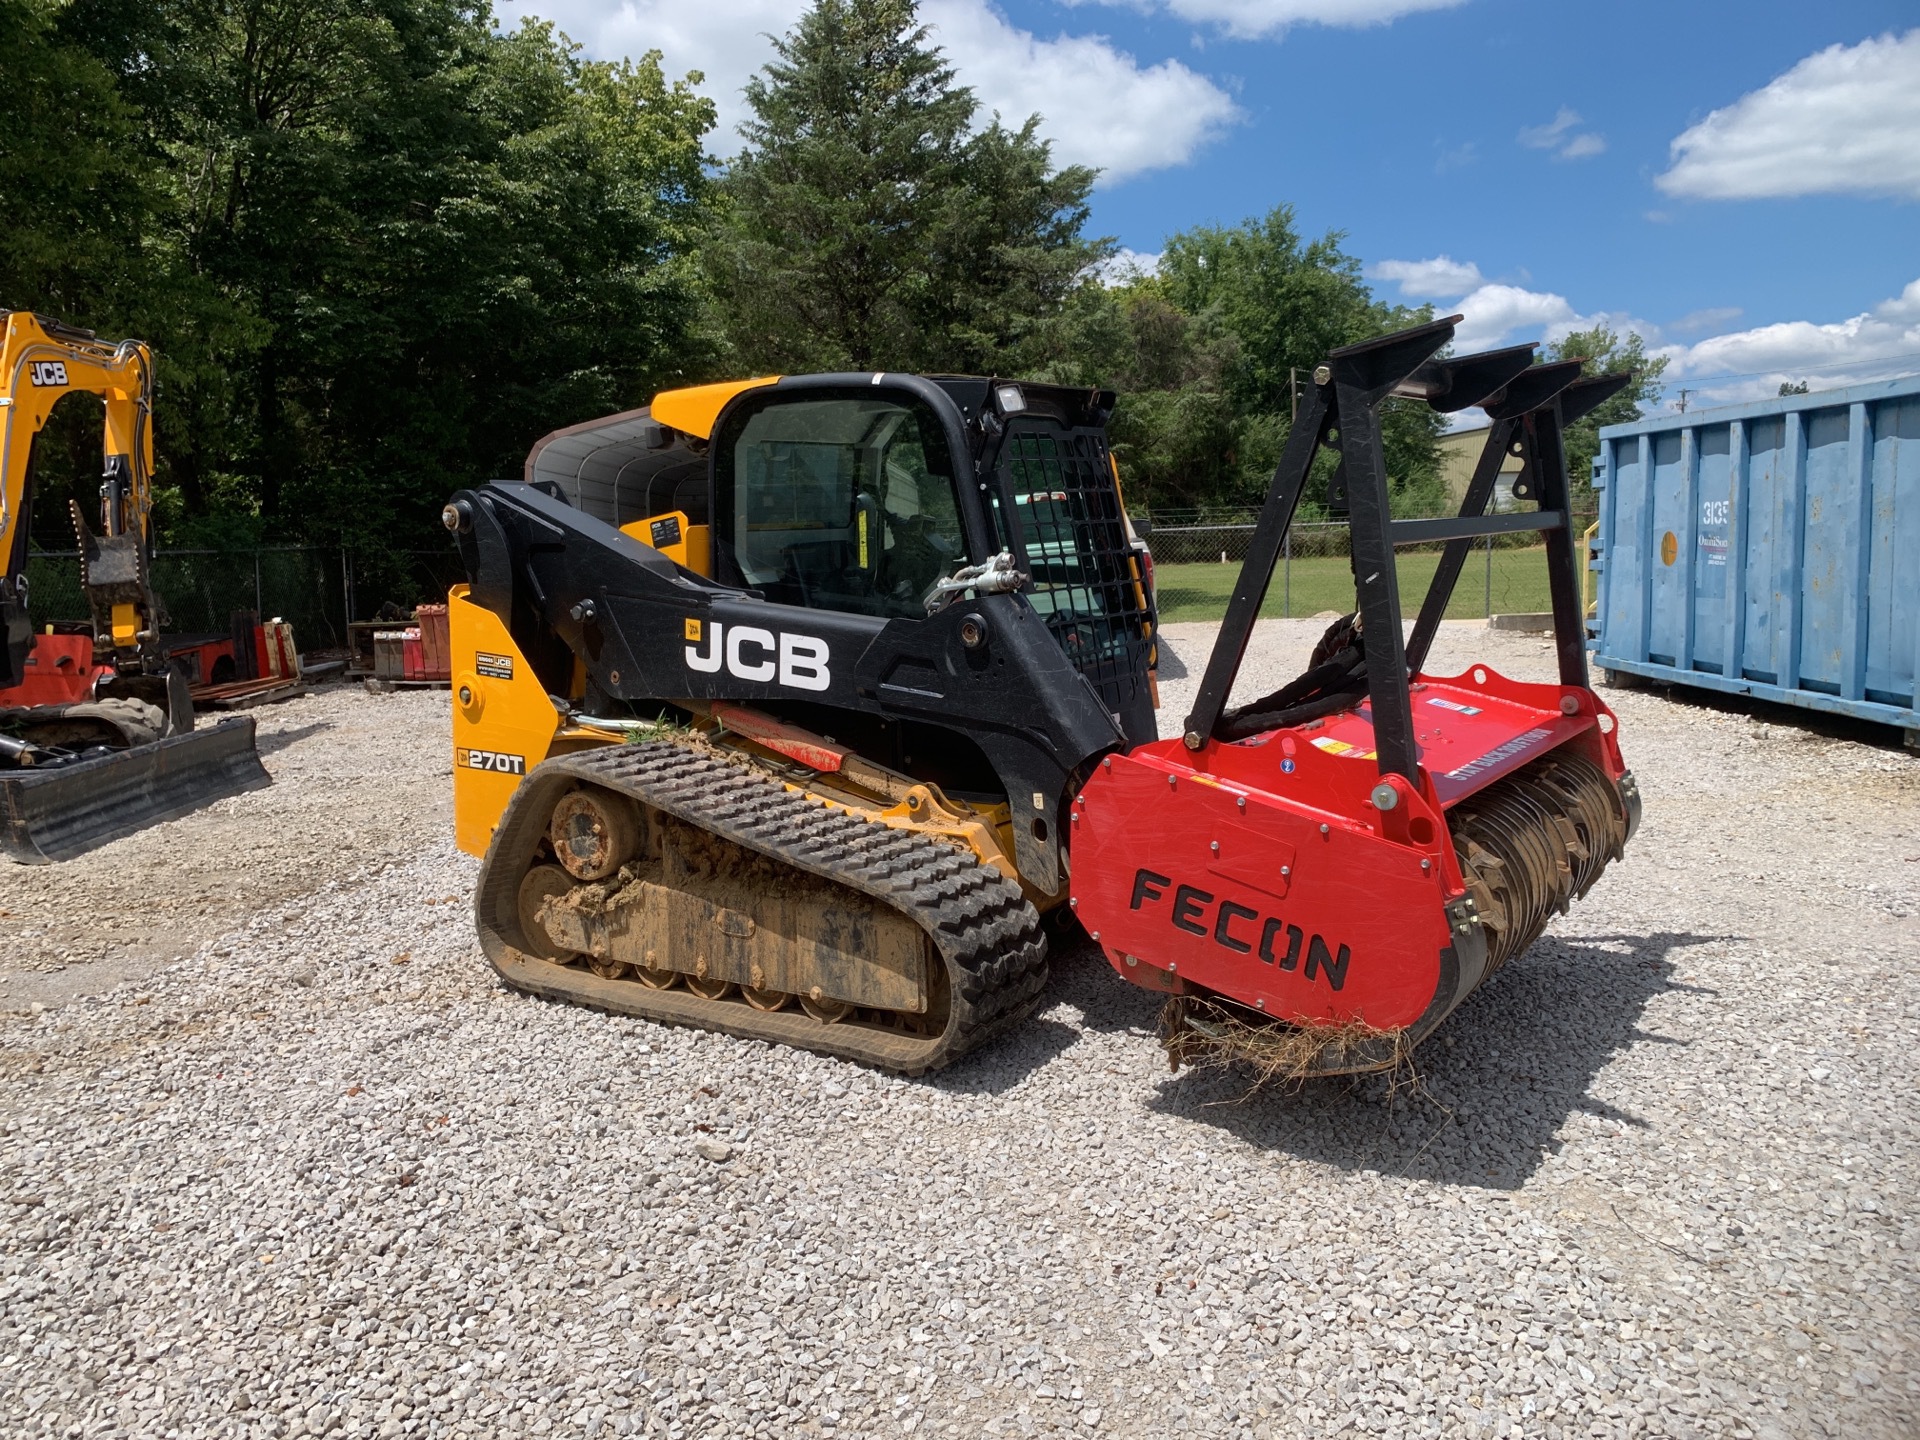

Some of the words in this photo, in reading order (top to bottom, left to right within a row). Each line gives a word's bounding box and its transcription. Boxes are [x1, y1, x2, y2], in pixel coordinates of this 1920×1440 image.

[30, 362, 69, 386] JCB
[495, 657, 512, 667] JCB
[685, 621, 831, 692] JCB
[469, 750, 523, 774] 270T
[1444, 763, 1485, 781] STAY
[1470, 750, 1512, 768] BACK
[1130, 868, 1351, 991] FECON
